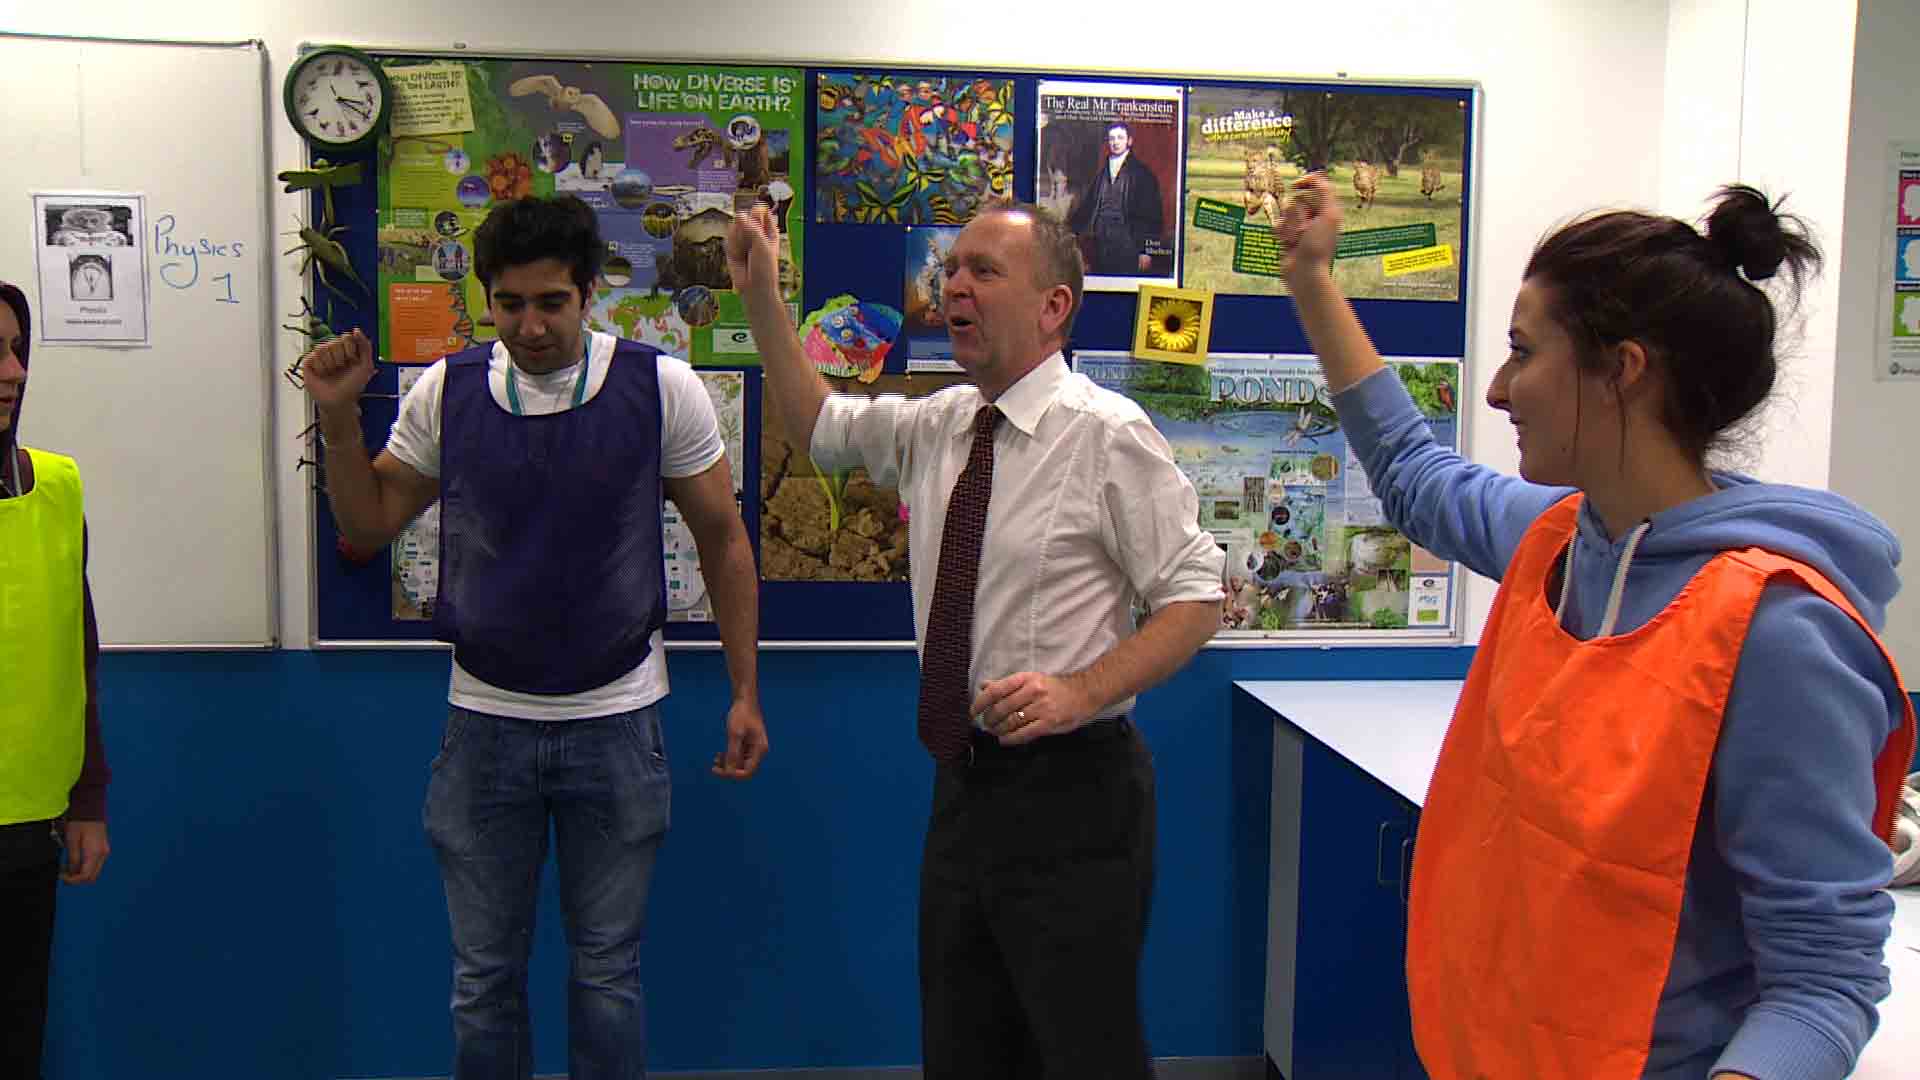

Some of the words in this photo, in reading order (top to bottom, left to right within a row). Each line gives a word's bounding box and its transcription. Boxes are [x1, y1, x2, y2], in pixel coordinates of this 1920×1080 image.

[633, 73, 681, 91] HOW
[687, 73, 768, 93] DIVERSE
[773, 76, 792, 94] IS
[637, 91, 679, 110] LIFE
[684, 93, 713, 111] ON
[718, 94, 792, 112] EARTH?
[1046, 96, 1065, 110] The
[1067, 97, 1089, 110] Real
[1093, 98, 1107, 110] Mr
[1111, 99, 1173, 113] Frankenstein
[1233, 108, 1265, 120] Make
[1201, 116, 1293, 135] difference
[155, 214, 244, 289] Physics
[210, 272, 241, 304] 1
